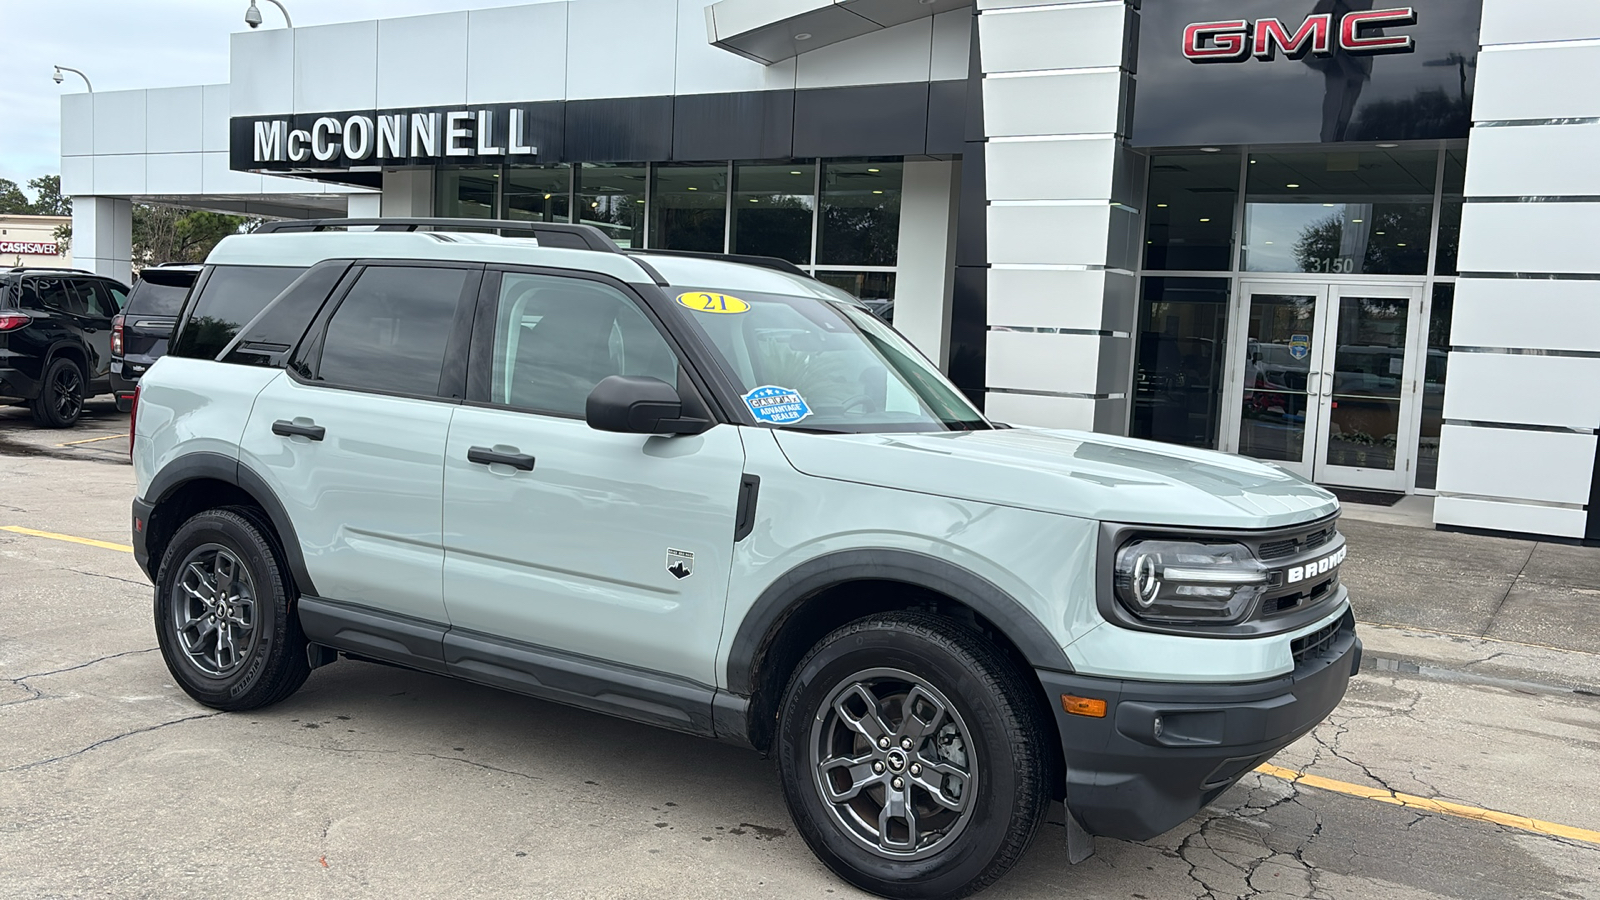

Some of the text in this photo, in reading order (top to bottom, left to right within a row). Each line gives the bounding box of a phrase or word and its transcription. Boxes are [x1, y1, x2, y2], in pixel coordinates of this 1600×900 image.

[1182, 7, 1415, 62] GMC
[254, 108, 537, 161] McCONNELL
[1311, 257, 1354, 273] 3150
[699, 294, 728, 311] 21
[750, 395, 799, 408] CARFAX
[760, 404, 802, 415] ADVANTAGE
[771, 411, 800, 421] DEALER
[232, 659, 260, 696] MICHELIN
